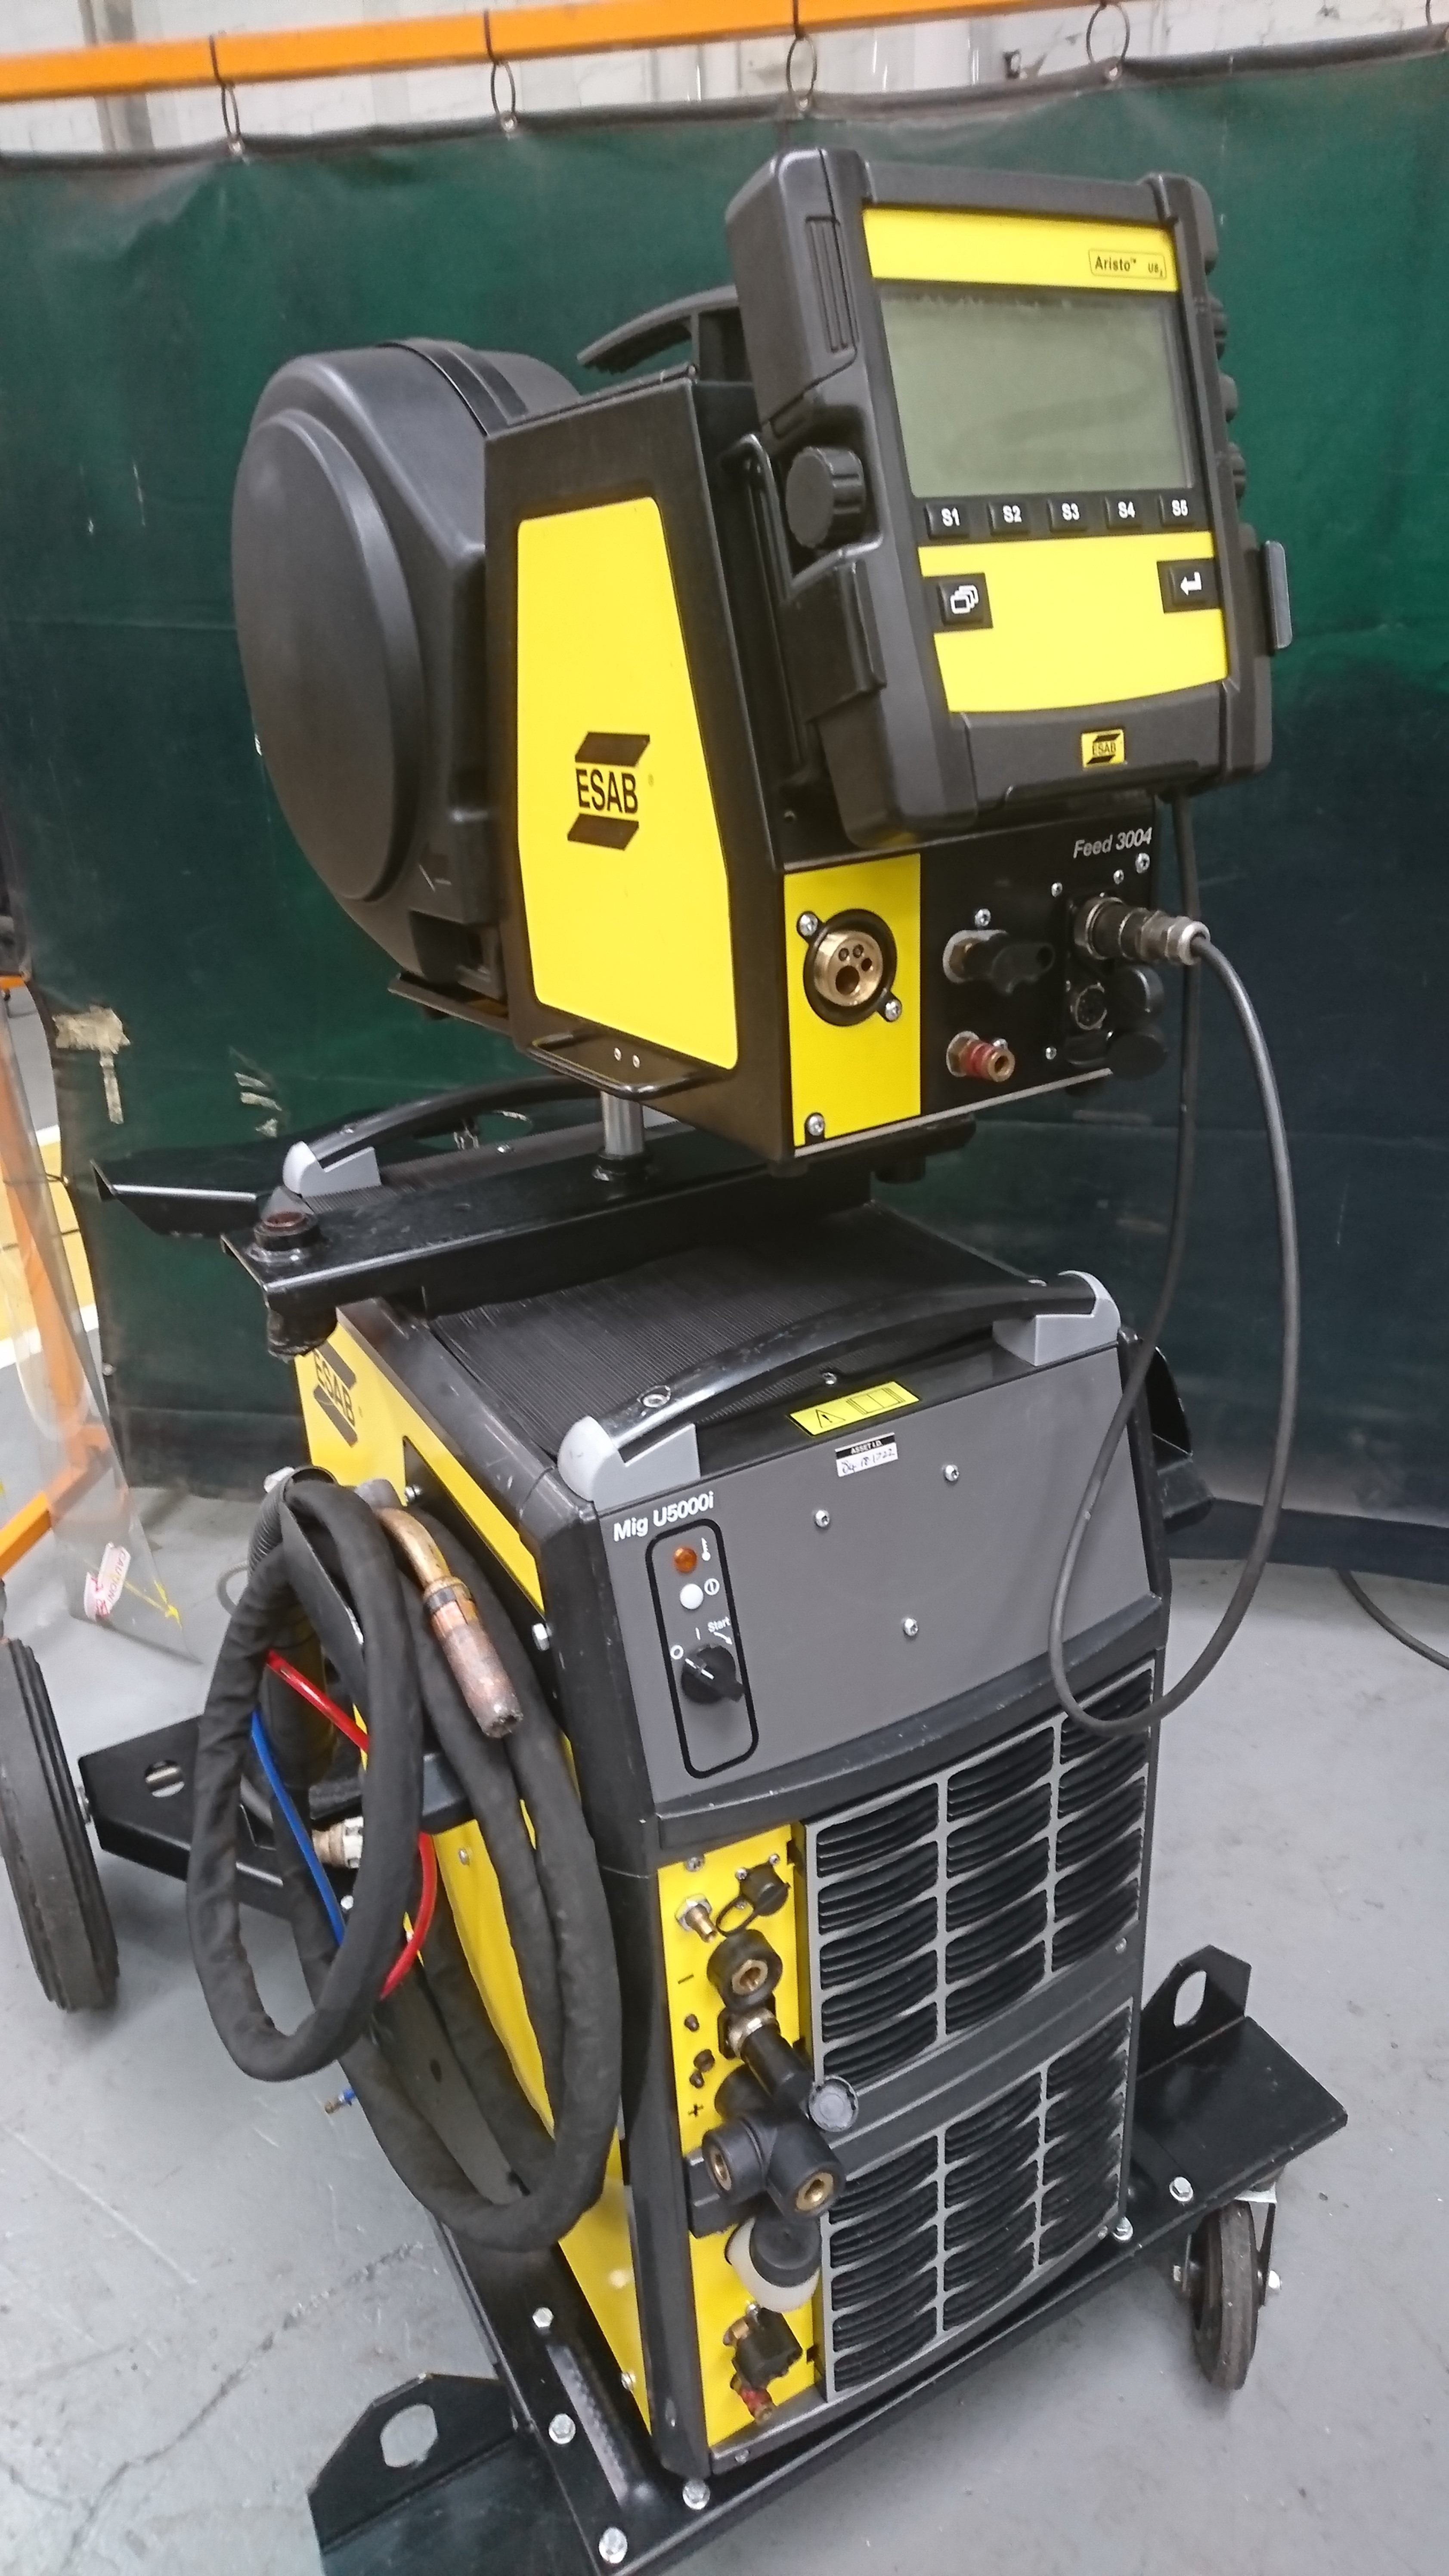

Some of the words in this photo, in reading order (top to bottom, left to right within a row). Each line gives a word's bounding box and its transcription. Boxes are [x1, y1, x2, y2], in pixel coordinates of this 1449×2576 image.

[941, 508, 960, 526] S1
[1003, 505, 1022, 523] S2
[1062, 503, 1080, 520] S3
[1118, 501, 1135, 518] S4
[1171, 499, 1189, 516] S5
[576, 768, 638, 814] ESAB
[1073, 834, 1113, 858] Feed
[1116, 827, 1153, 851] 3004
[313, 1349, 356, 1427] ESAB
[613, 1517, 648, 1542] Mig
[653, 1491, 714, 1527] U5000i
[708, 1616, 731, 1632] Start
